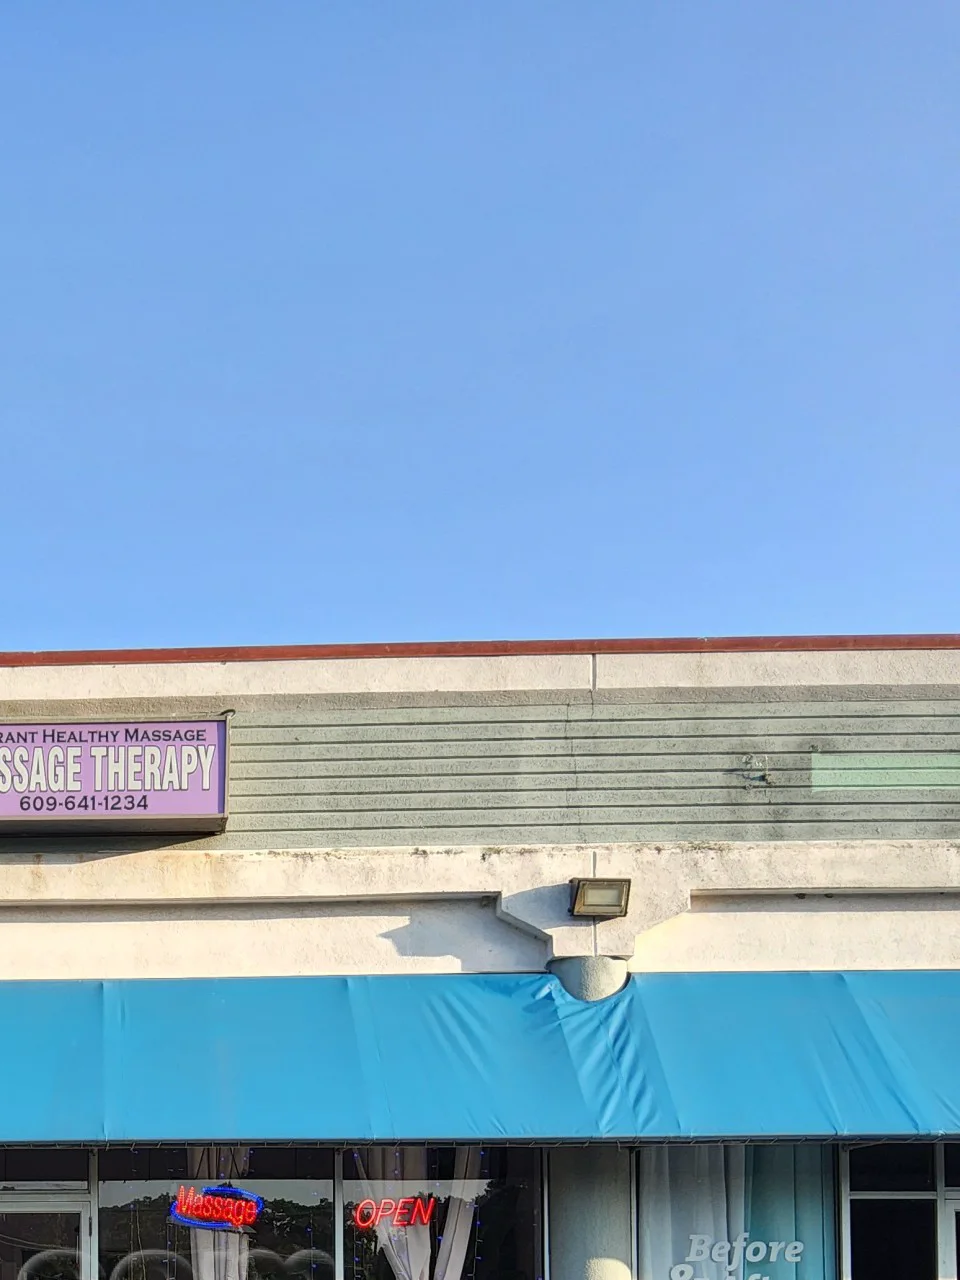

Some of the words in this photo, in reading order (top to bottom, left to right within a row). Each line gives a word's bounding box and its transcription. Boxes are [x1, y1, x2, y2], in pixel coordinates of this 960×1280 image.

[42, 729, 120, 744] HEALTHY
[124, 728, 207, 743] MASSAGE
[90, 744, 217, 792] THERAPY
[19, 794, 149, 811] 609-641-1234
[176, 1185, 257, 1227] Massage
[356, 1197, 435, 1227] OPEN
[685, 1232, 805, 1271] Before
